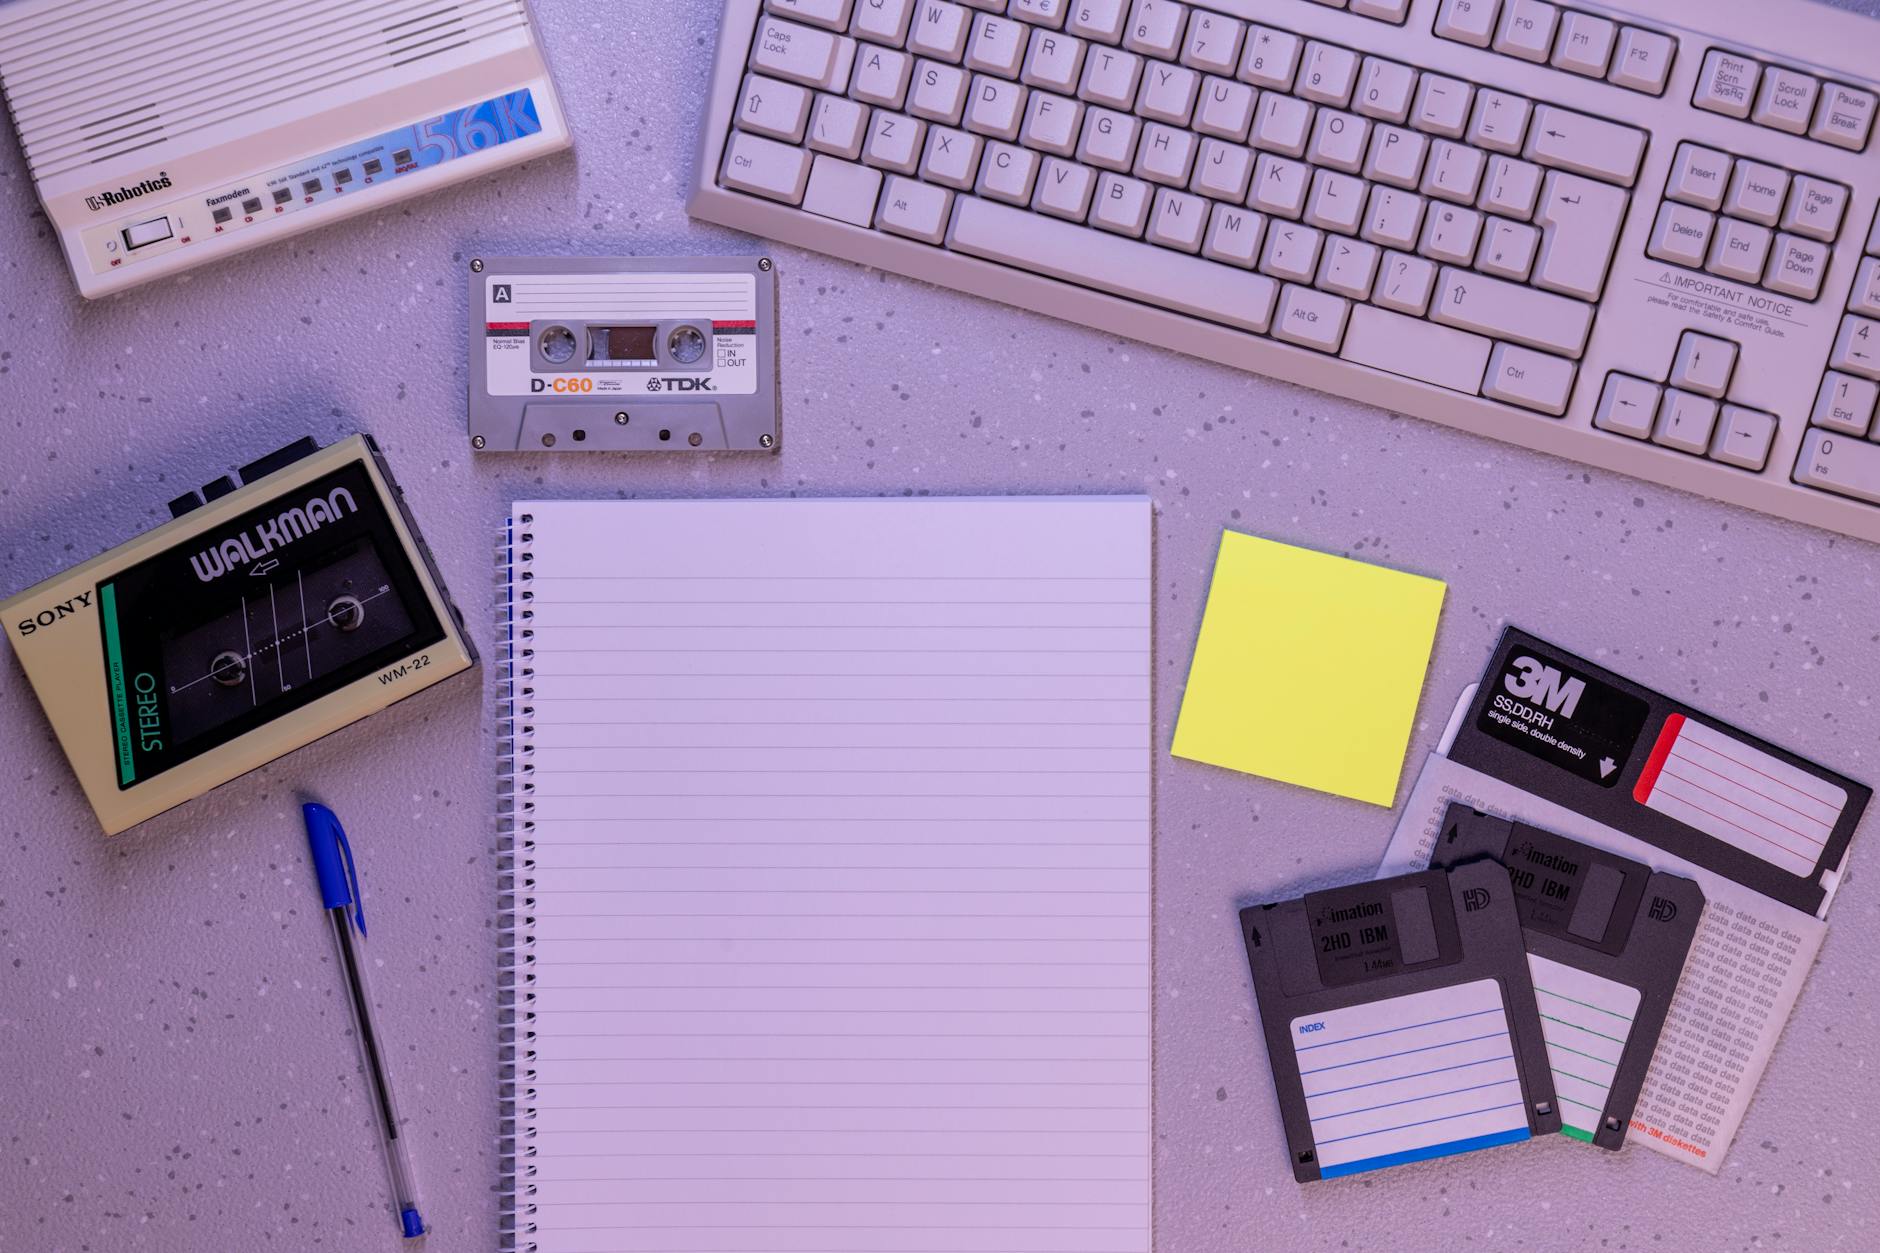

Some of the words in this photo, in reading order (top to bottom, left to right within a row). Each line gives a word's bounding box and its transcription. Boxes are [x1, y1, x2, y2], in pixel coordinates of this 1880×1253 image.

[927, 7, 942, 24] W
[1081, 9, 1090, 22] 5
[1456, 1, 1472, 14] F9
[984, 23, 997, 39] E
[1138, 25, 1147, 37] 6
[1514, 16, 1533, 31] F10
[767, 27, 791, 43] Caps
[1572, 31, 1589, 46] F11
[764, 40, 787, 55] Lock
[1041, 39, 1056, 56] R
[1197, 41, 1205, 53] 7
[1630, 47, 1648, 62] F12
[868, 55, 881, 71] A
[1102, 55, 1114, 71] T
[1254, 57, 1263, 69] 8
[1720, 57, 1744, 74] Print
[925, 71, 938, 86] S
[1159, 71, 1172, 86] Y
[1312, 73, 1321, 85] 9
[1716, 70, 1739, 85] Scrn
[982, 86, 997, 102] D
[1214, 86, 1228, 102] U
[1714, 81, 1744, 102] SysRq
[1778, 81, 1807, 98] Scroll
[1774, 95, 1799, 111] Lock
[1837, 91, 1866, 108] Pause
[1039, 102, 1052, 116] F
[412, 88, 542, 165] 56K
[881, 121, 895, 137] Z
[1097, 118, 1113, 134] G
[1831, 114, 1858, 131] Break
[938, 136, 952, 153] X
[1154, 133, 1170, 150] H
[1386, 133, 1399, 148] P
[735, 155, 753, 169] Ctrl
[997, 153, 1011, 168] C
[1213, 150, 1225, 165] J
[1055, 168, 1069, 184] V
[1269, 165, 1284, 181] K
[1690, 164, 1716, 182] Insert
[1110, 183, 1125, 200] B
[1327, 180, 1338, 197] L
[1747, 181, 1776, 198] Home
[206, 187, 250, 207] Faxmodem
[893, 199, 907, 211] Alt
[1808, 190, 1833, 204] Page
[1167, 199, 1182, 216] N
[1805, 202, 1818, 214] Up
[1224, 214, 1242, 232] M
[1673, 221, 1703, 239] Delete
[1729, 236, 1749, 253] End
[110, 258, 122, 267] OFF
[1788, 247, 1814, 264] Page
[1785, 259, 1814, 276] Down
[496, 287, 509, 301] A
[1674, 275, 1744, 302] IMPORTANT
[1747, 295, 1793, 317] NOTICE
[1647, 296, 1669, 307] please
[1671, 302, 1687, 311] read
[1688, 305, 1701, 314] the
[1702, 308, 1725, 322] Safety
[1734, 318, 1762, 331] Comfort
[1680, 296, 1722, 313] comfortable
[1723, 308, 1737, 317] and
[1738, 311, 1753, 321] safe
[1858, 325, 1869, 340] 4
[727, 349, 736, 357] IN
[727, 358, 747, 367] OUT
[1506, 365, 1525, 380] Ctrl
[531, 377, 592, 393] D-C60
[661, 377, 712, 391] TDK
[1841, 383, 1848, 398] 1
[1833, 407, 1853, 421] End
[189, 486, 359, 582] WALKMAN
[17, 590, 94, 638] SONY
[113, 662, 122, 692] PLAYER
[378, 654, 431, 687] WM-22
[1504, 656, 1586, 719] 3M
[116, 692, 127, 733] CASSETTE
[134, 672, 163, 752] STEREO
[1488, 709, 1511, 725] single
[1511, 720, 1529, 735] side,
[1530, 728, 1557, 746] double
[1557, 740, 1587, 760] density
[122, 735, 131, 766] STEREO
[1441, 784, 1463, 799] data
[1464, 794, 1485, 809] data
[1487, 804, 1507, 819] data
[1541, 878, 1570, 901] IBM
[1713, 900, 1734, 915] data
[1736, 910, 1756, 925] data
[1759, 920, 1779, 935] data
[1781, 930, 1802, 945] data
[1321, 931, 1352, 953] 2HD
[1360, 925, 1389, 945] IBM
[1694, 942, 1715, 958] data
[1717, 953, 1737, 968] data
[1739, 963, 1760, 978] data
[1762, 973, 1782, 988] data
[1675, 985, 1695, 1000] data
[1698, 995, 1718, 1011] data
[1720, 1005, 1741, 1021] data
[1743, 1015, 1763, 1031] data
[1299, 1021, 1326, 1034] INDEX
[1669, 1059, 1689, 1075] data
[1692, 1069, 1712, 1085] data
[1714, 1079, 1735, 1095] data
[1645, 1113, 1666, 1128] data
[1668, 1123, 1688, 1138] data
[1691, 1133, 1711, 1148] data
[1647, 1126, 1663, 1140] 3M
[1663, 1134, 1707, 1158] diskettes
